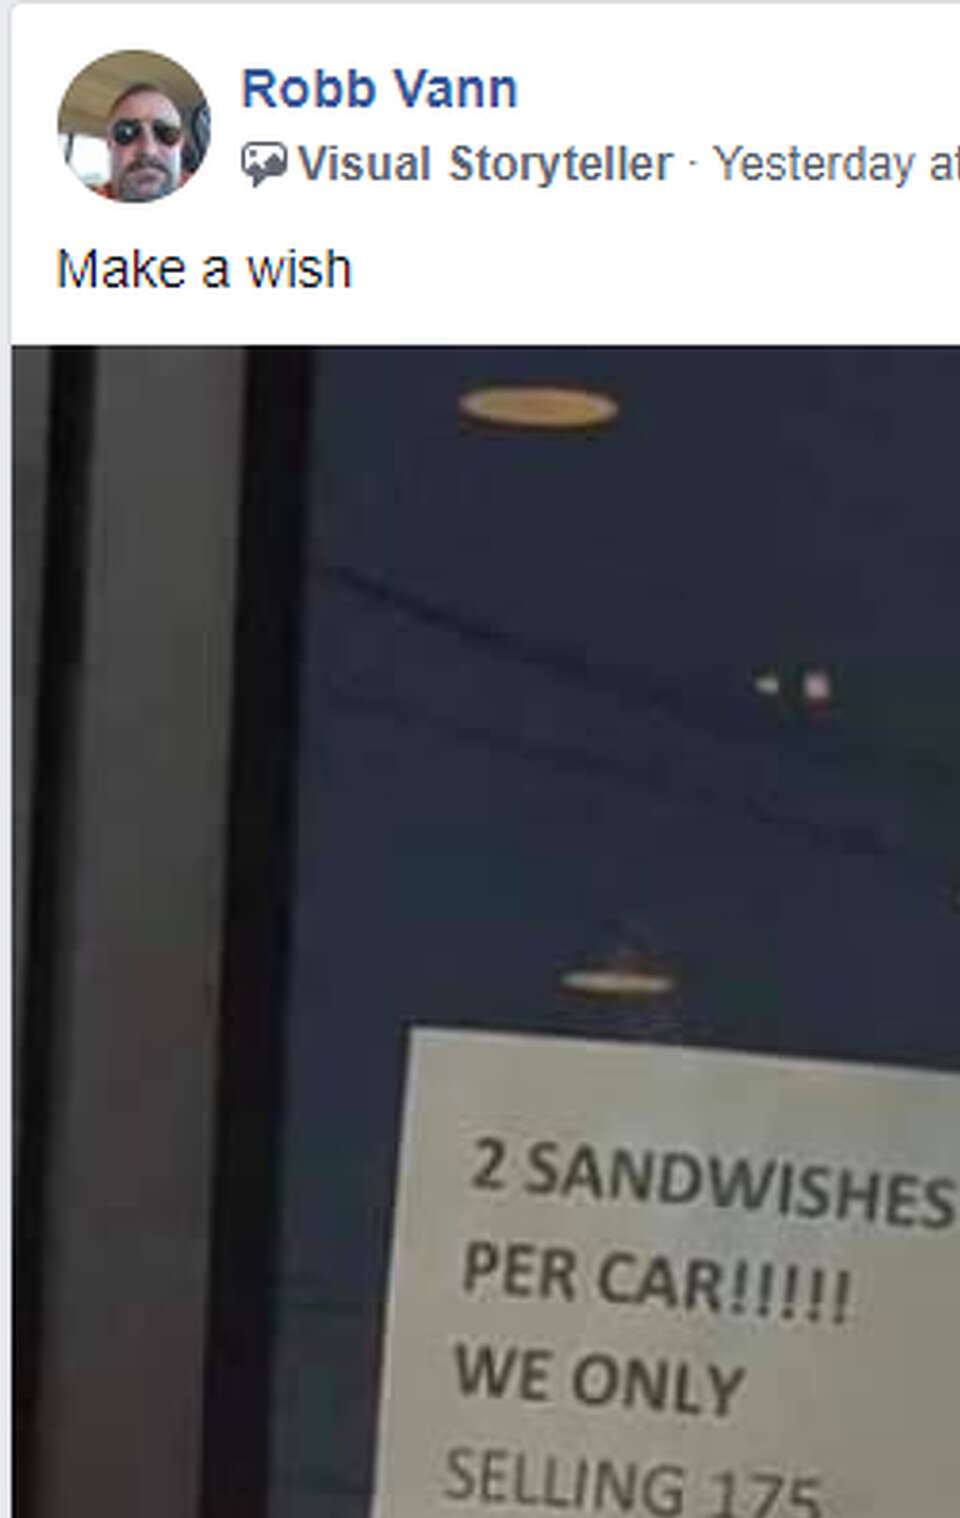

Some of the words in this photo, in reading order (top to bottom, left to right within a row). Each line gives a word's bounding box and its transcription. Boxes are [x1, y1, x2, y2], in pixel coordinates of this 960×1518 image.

[472, 1137, 506, 1190] 2
[525, 1141, 959, 1230] SANDWISHES
[463, 1241, 577, 1302] PER
[598, 1249, 852, 1325] CAR!!!!!
[453, 1343, 554, 1401] WE
[572, 1353, 746, 1418] ONLY
[444, 1446, 685, 1518] SELLING
